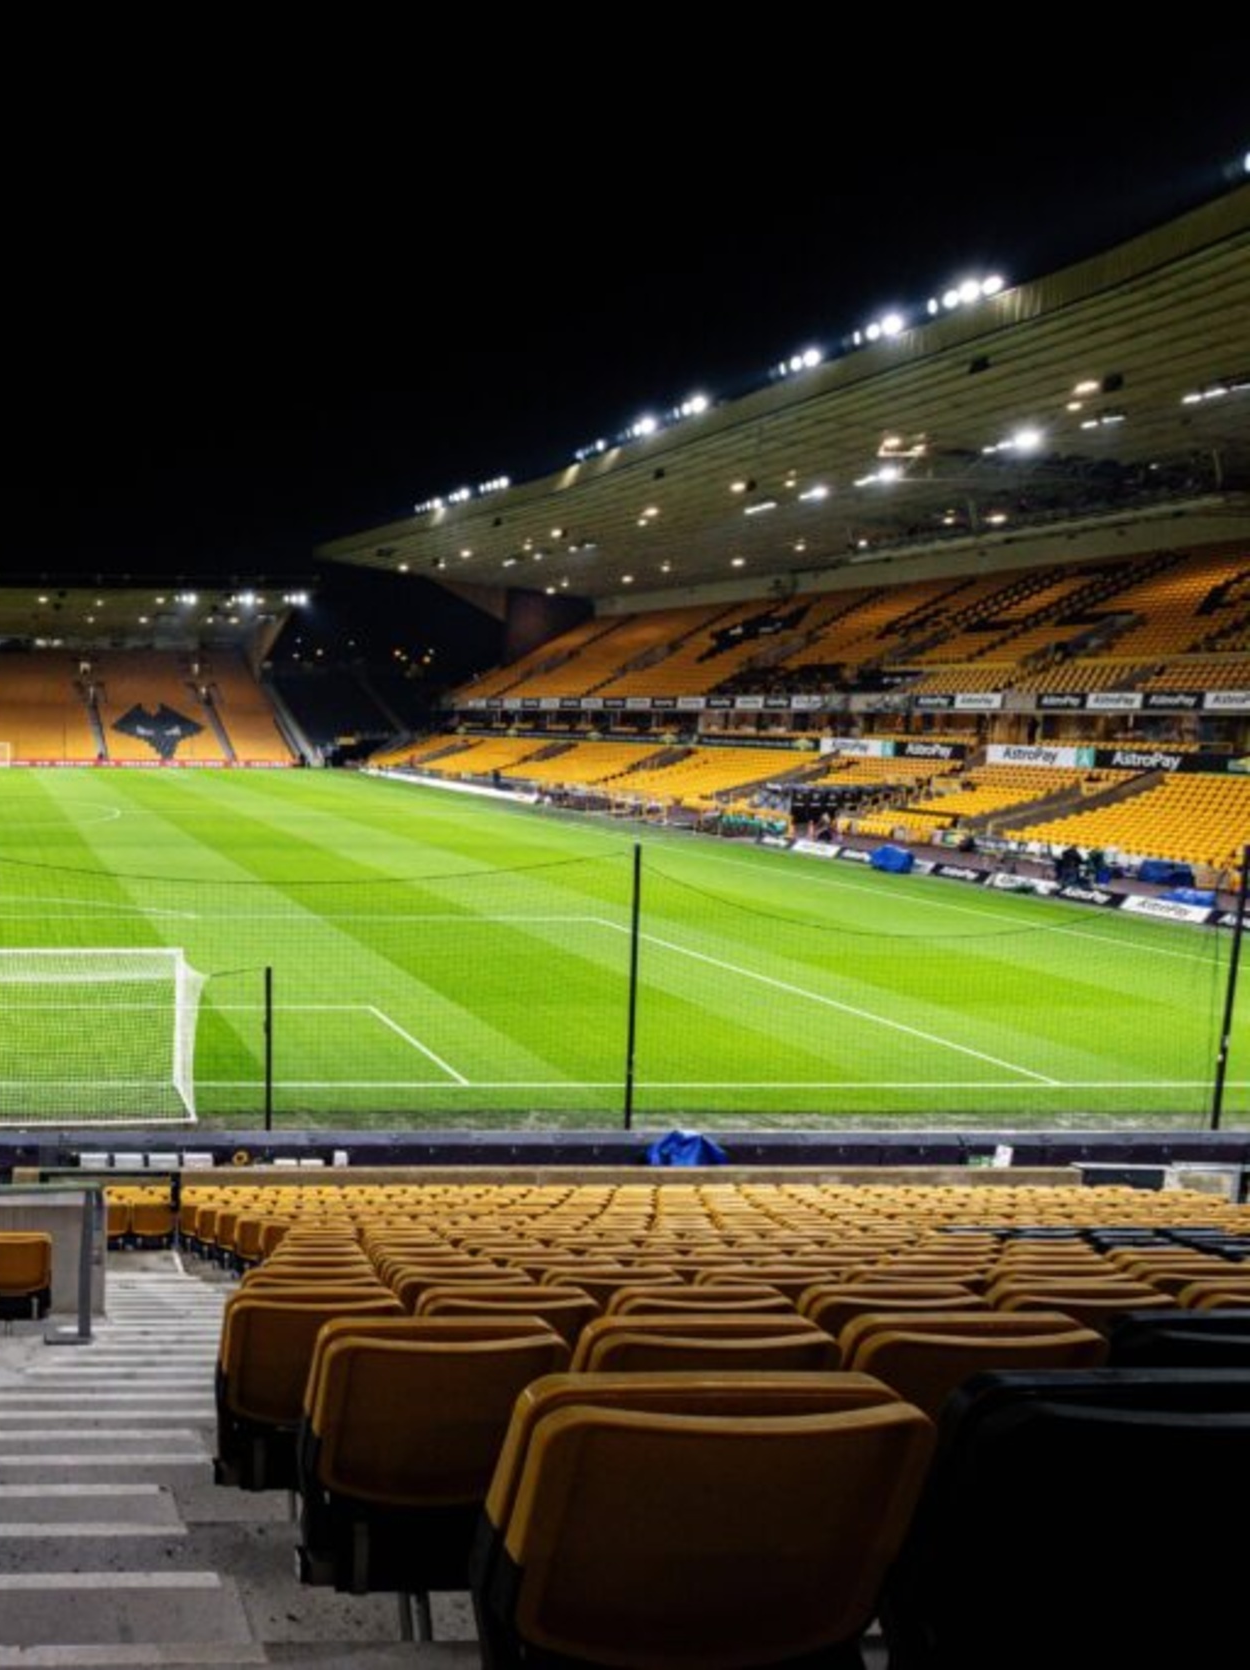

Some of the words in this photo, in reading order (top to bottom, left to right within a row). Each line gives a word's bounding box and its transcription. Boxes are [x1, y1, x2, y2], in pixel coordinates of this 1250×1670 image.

[906, 743, 953, 759] AstroPay
[1002, 749, 1059, 764] AstroPay
[1111, 751, 1182, 770] AstroPay
